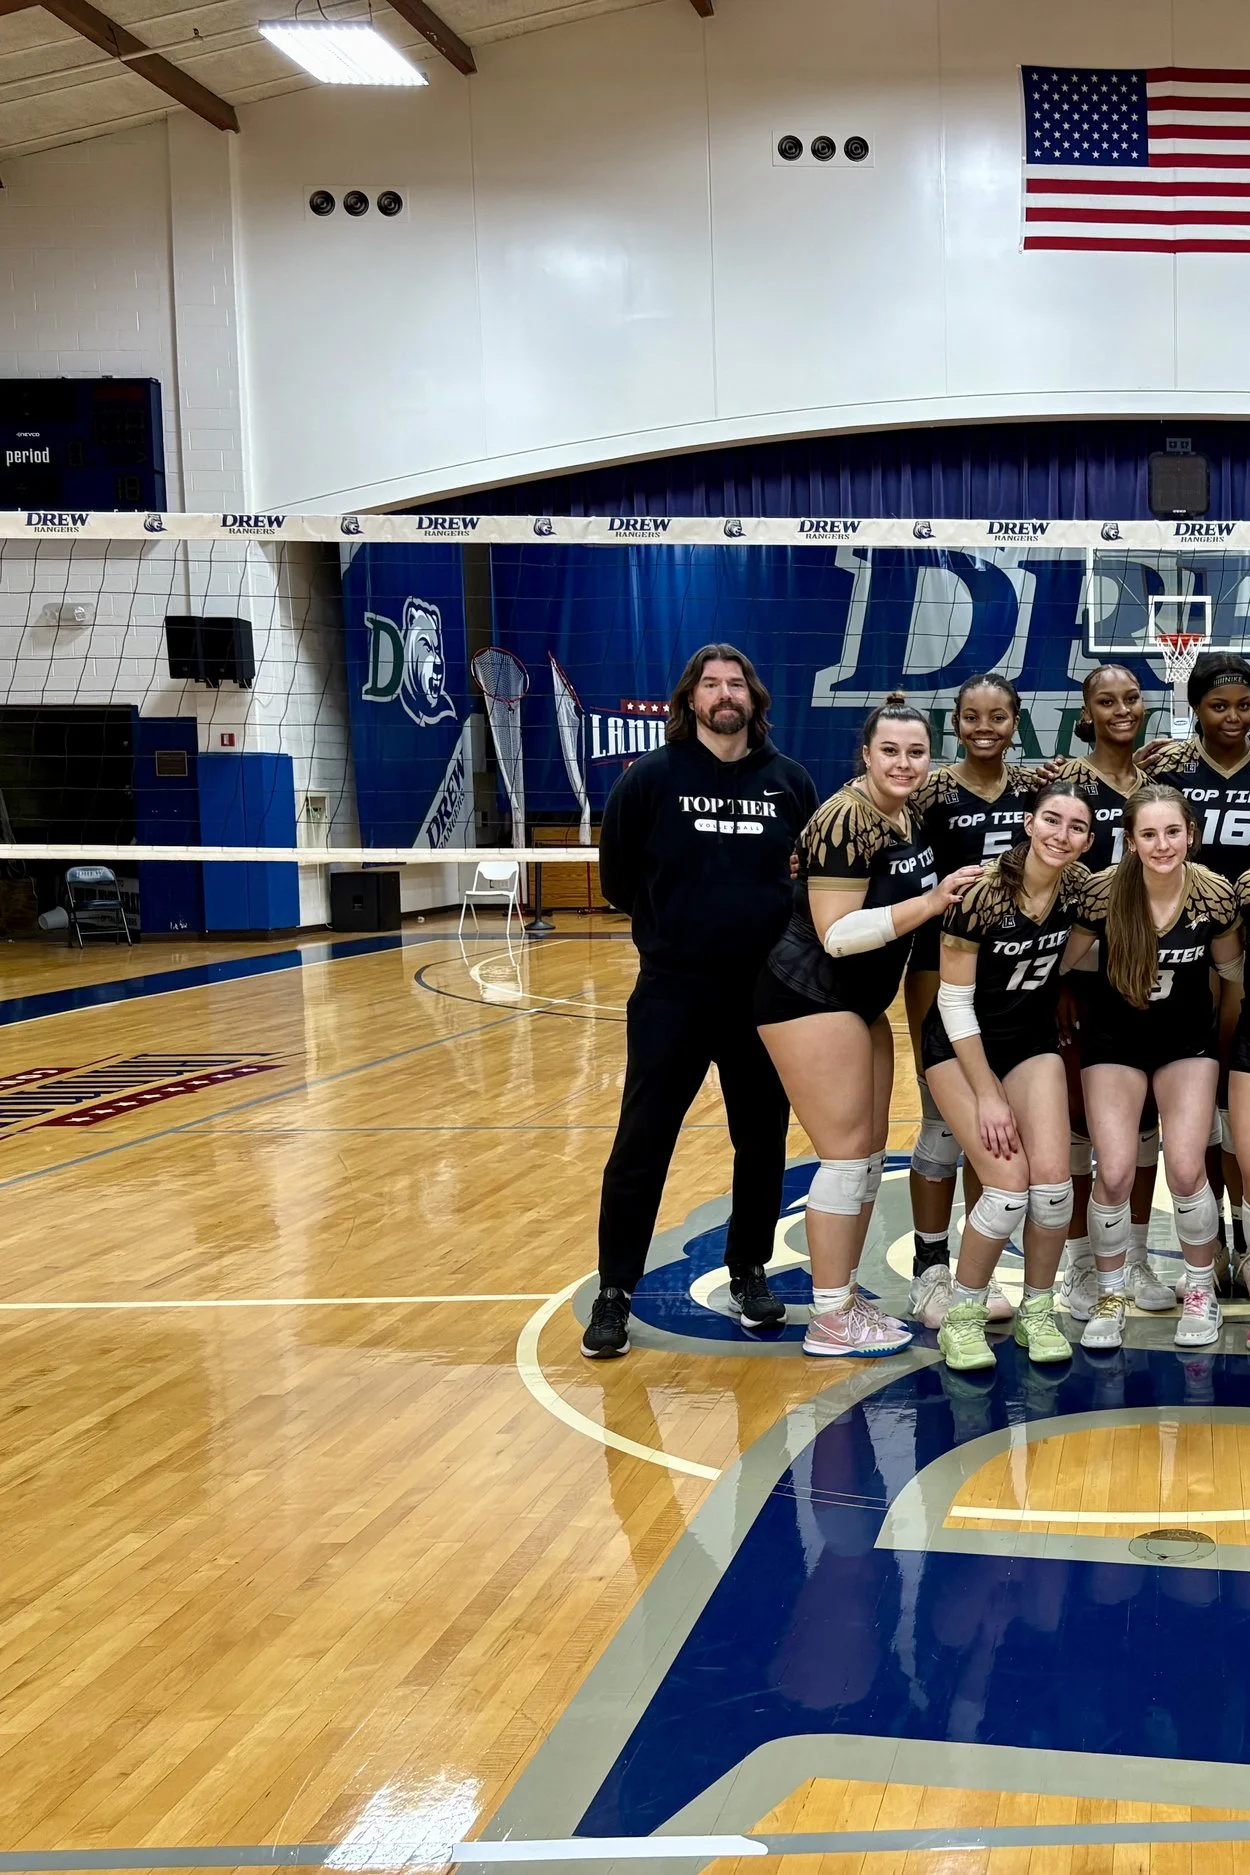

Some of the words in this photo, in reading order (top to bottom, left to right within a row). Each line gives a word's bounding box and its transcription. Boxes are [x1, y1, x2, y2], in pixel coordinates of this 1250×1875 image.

[6, 447, 50, 467] period
[26, 513, 88, 526] DREW
[220, 513, 287, 527] DREW
[416, 516, 480, 529] DREW
[608, 518, 671, 531] DREW
[798, 519, 861, 532] DREW
[987, 521, 1049, 534] DREW
[1173, 522, 1235, 535] DREW
[590, 714, 668, 758] LAND
[425, 751, 466, 847] DREW
[1182, 788, 1220, 802] TOP
[678, 796, 724, 814] TOP
[727, 799, 778, 818] TIER
[1094, 808, 1123, 821] OP
[948, 813, 986, 829] TOP
[991, 812, 1024, 825] TIE
[889, 859, 917, 875] TOP
[917, 845, 934, 868] TIE
[992, 940, 1033, 956] TOP
[1158, 945, 1205, 964] TIER
[1005, 953, 1059, 991] 13
